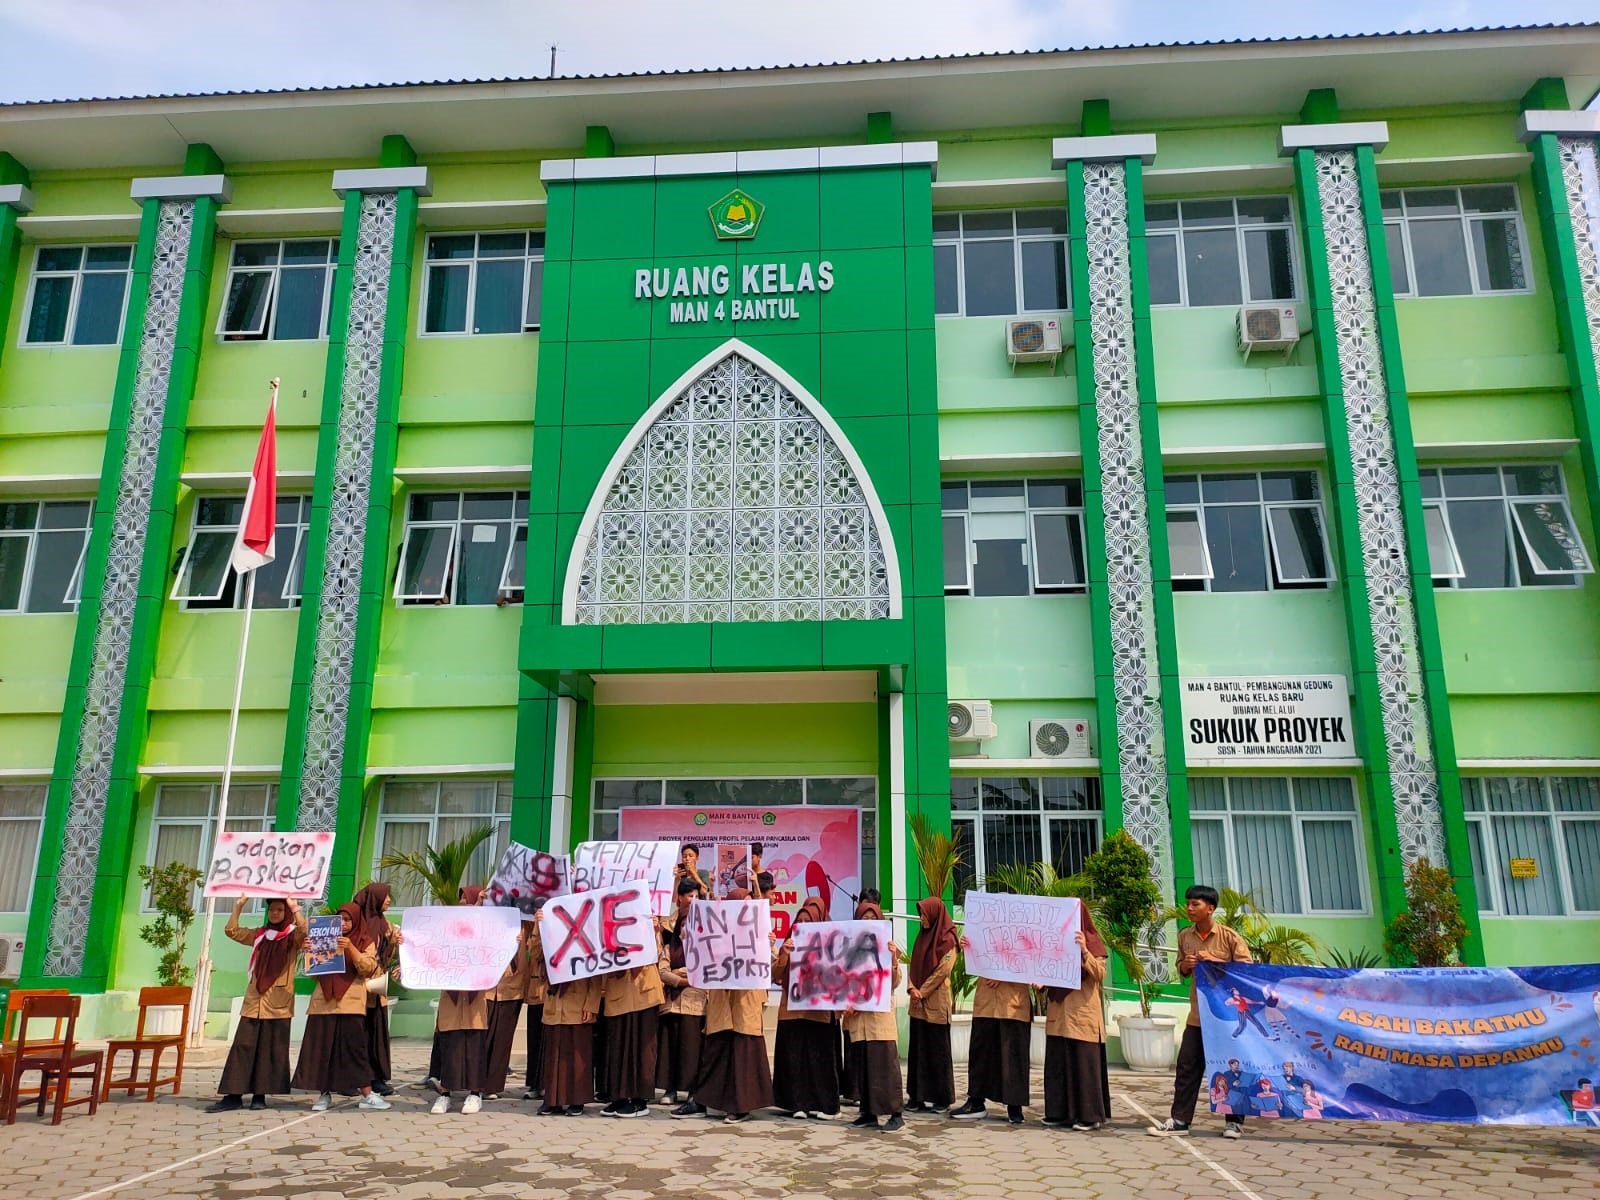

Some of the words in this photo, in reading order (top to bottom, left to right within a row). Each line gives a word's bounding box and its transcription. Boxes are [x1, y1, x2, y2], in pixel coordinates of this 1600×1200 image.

[635, 264, 730, 299] RUANG
[742, 261, 835, 294] KELAS
[670, 301, 709, 323] MAN
[714, 300, 726, 321] 4
[731, 298, 800, 321] BANTUL
[1188, 682, 1205, 692] MAN
[1206, 683, 1212, 692] 4
[1214, 682, 1242, 691] BANTUL
[1246, 681, 1302, 691] PEMBANGUNAN
[1304, 681, 1333, 690] GEDUNG
[1220, 693, 1250, 703] RUANG
[1253, 693, 1279, 702] KELAS
[1282, 693, 1304, 702] BARU
[1233, 705, 1261, 715] DIBIAYAI
[1263, 705, 1295, 714] MELALUI
[1190, 718, 1260, 744] SUKUK
[1263, 717, 1346, 743] PROYEK
[1217, 745, 1237, 755] SBSN
[1243, 745, 1266, 755] TAHUN
[1266, 745, 1304, 754] ANGGARAN
[1305, 744, 1322, 754] 2021
[571, 946, 631, 976] rose
[1337, 1007, 1411, 1034] ASAH
[1414, 1007, 1548, 1036] BAKATMU
[1333, 1034, 1389, 1061] RAIH
[1390, 1049, 1456, 1069] MASA
[1458, 1036, 1565, 1069] DEPANMU
